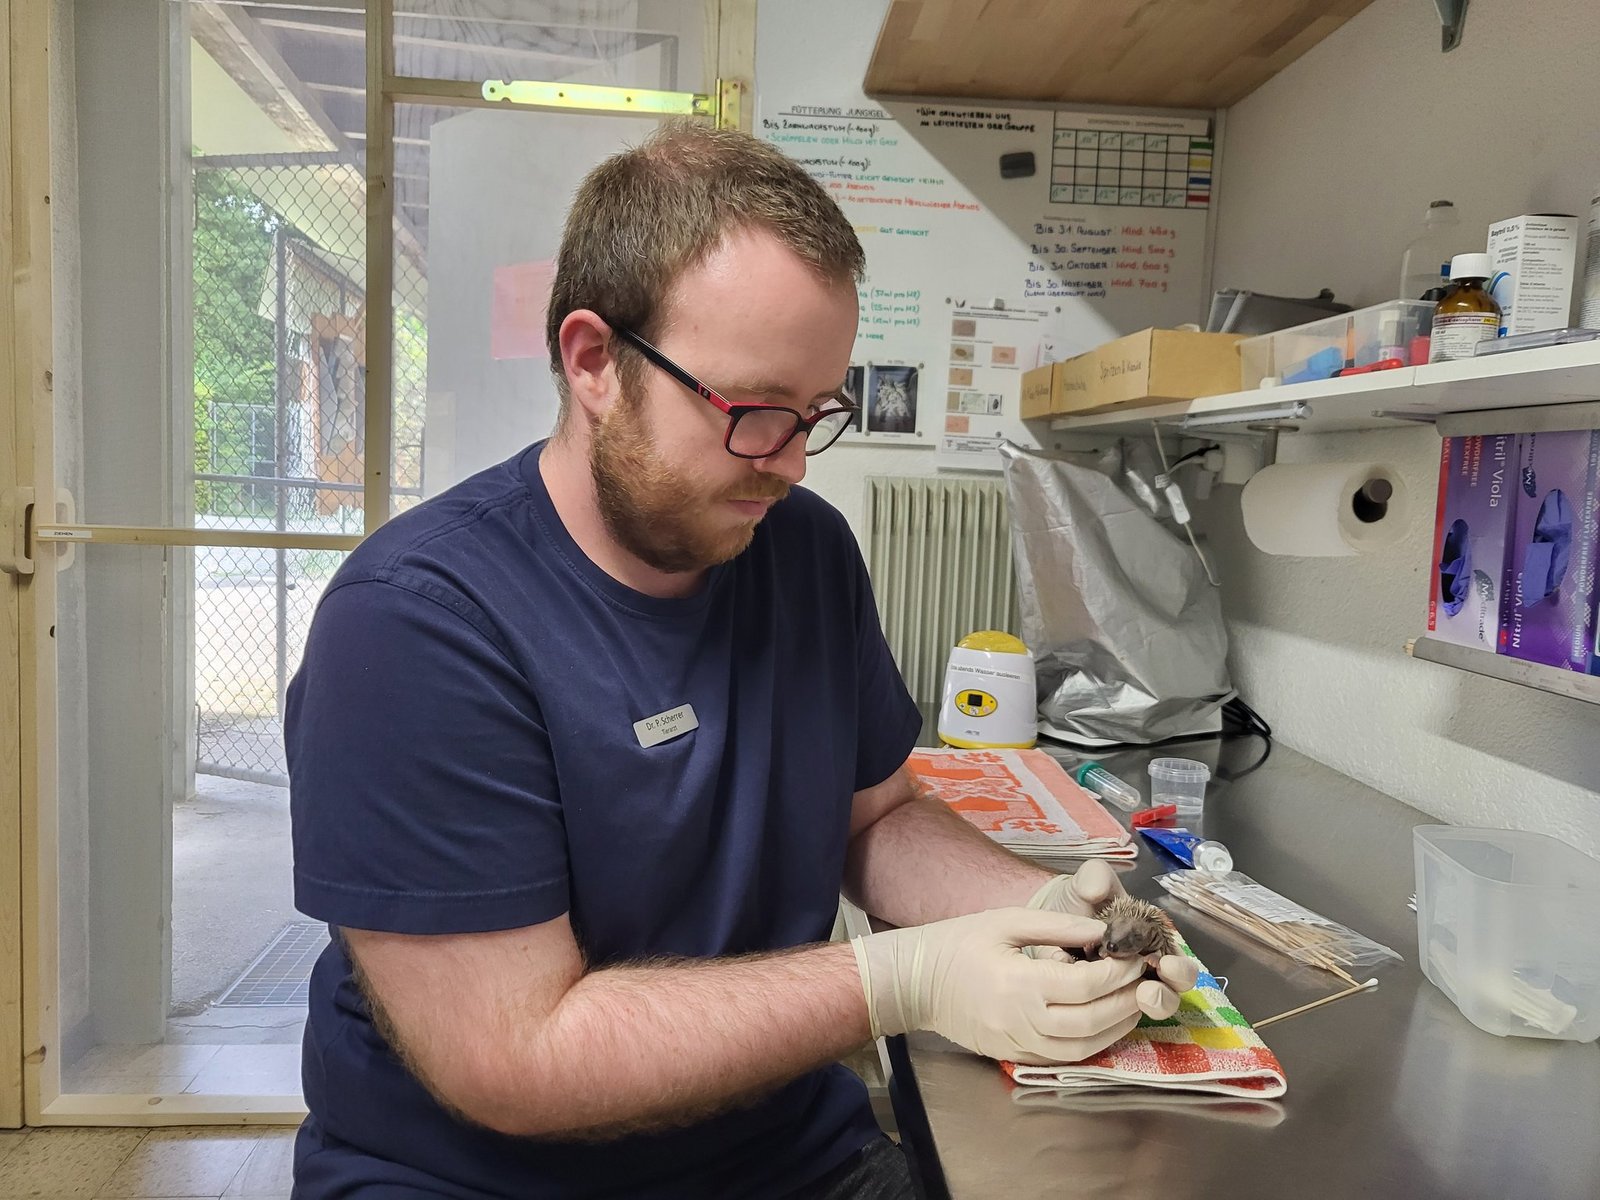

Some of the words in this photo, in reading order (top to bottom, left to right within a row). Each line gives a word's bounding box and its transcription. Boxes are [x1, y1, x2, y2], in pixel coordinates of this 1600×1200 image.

[1443, 438, 1451, 464] MALL
[1462, 436, 1471, 476] TEXFREE
[1471, 436, 1482, 487] OWDERFREE
[1490, 470, 1503, 507] Viola
[1579, 542, 1588, 592] POWDERFREE
[1584, 491, 1593, 533] LATEXFREE
[1574, 624, 1582, 657] MEDIUM
[646, 722, 656, 731] Dr.
[660, 712, 684, 725] Scherrer
